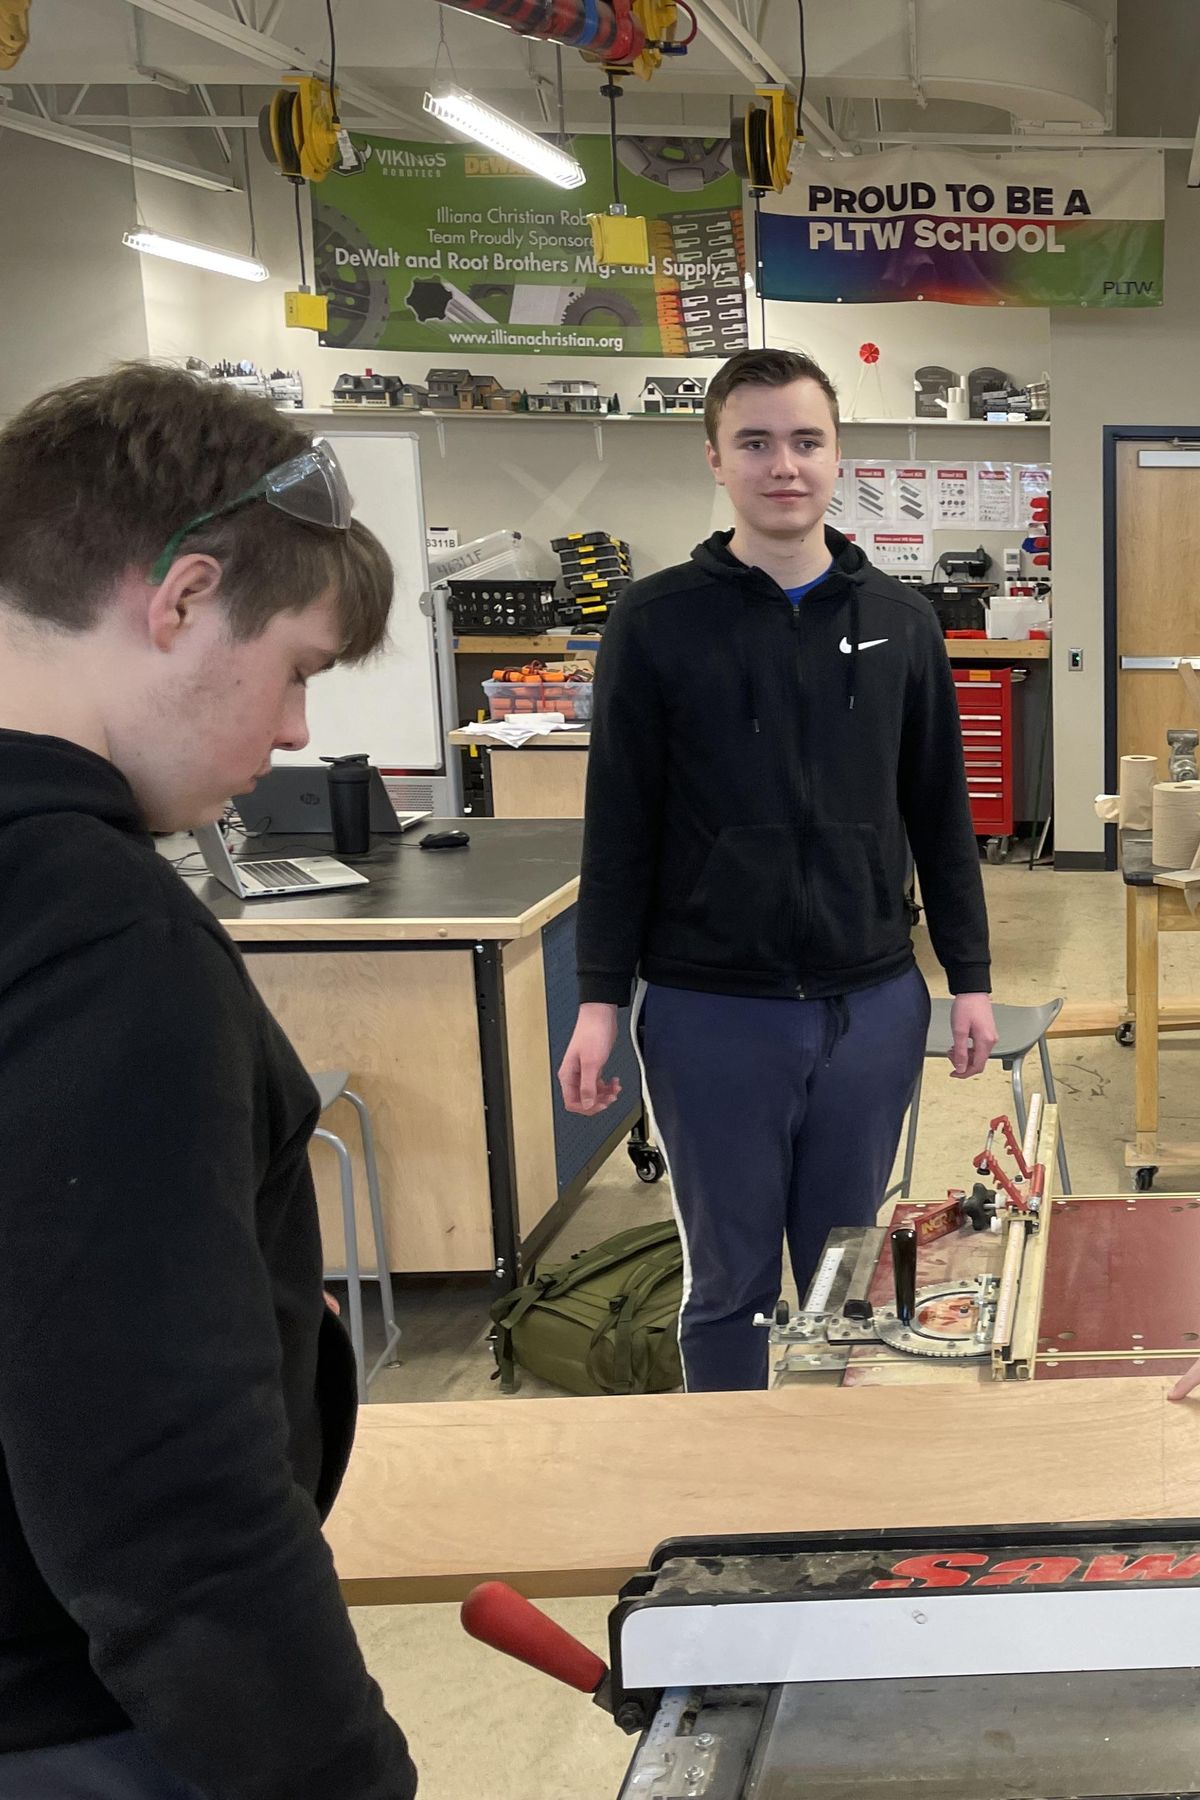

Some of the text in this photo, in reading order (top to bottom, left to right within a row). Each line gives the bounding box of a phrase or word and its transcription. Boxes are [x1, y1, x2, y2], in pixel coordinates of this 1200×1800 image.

[375, 149, 446, 167] VIKINGS
[808, 182, 1091, 216] PROUD TO BE A
[436, 206, 482, 224] Illiana
[487, 207, 555, 225] Christian
[427, 228, 466, 244] Team
[469, 229, 524, 248] Proudly
[808, 219, 1066, 253] PLTW SCHOOL
[335, 247, 401, 267] DeWalt
[405, 250, 441, 269] and
[447, 252, 488, 271] Root
[493, 252, 569, 273] Brothers
[662, 257, 726, 281] Supply.
[1103, 281, 1154, 295] PLTW
[449, 328, 623, 352] www.illianachristian.org
